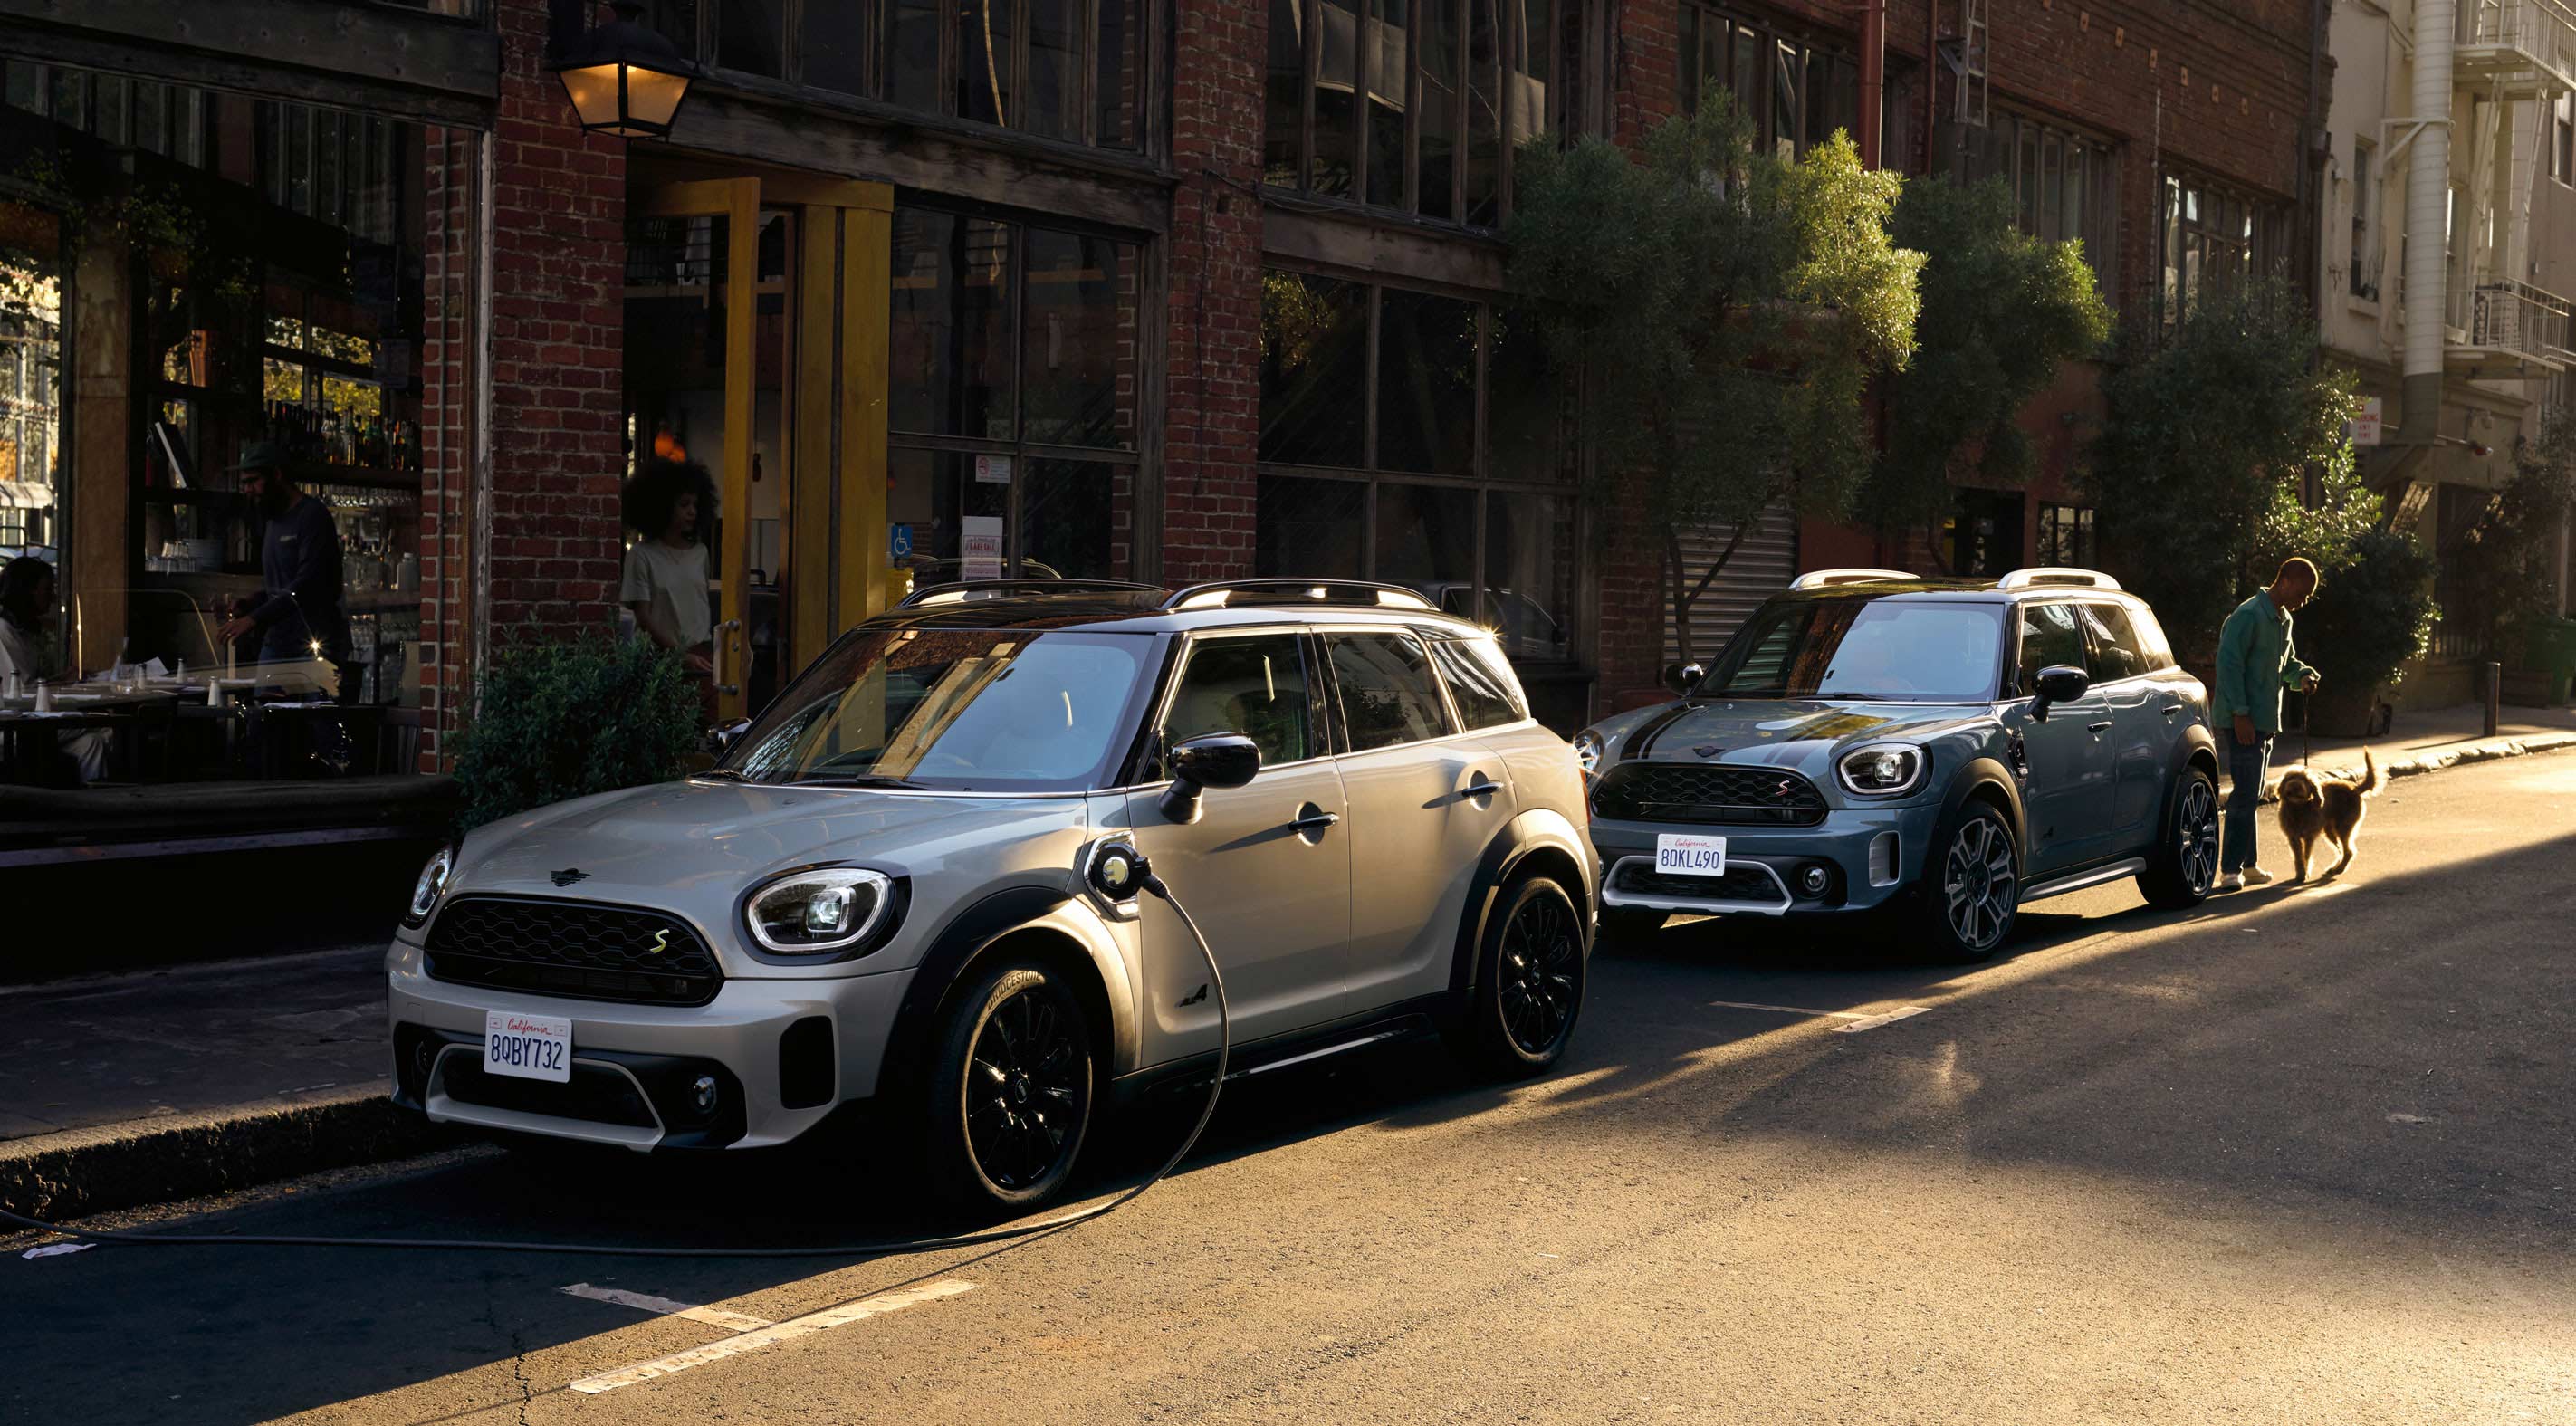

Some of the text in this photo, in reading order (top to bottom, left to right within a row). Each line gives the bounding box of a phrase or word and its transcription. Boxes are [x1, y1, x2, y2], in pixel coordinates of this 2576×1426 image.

[1775, 780, 1790, 797] S
[1674, 838, 1710, 848] California
[649, 928, 670, 954] S
[507, 1018, 553, 1036] California
[491, 1034, 563, 1070] 8QBY732
